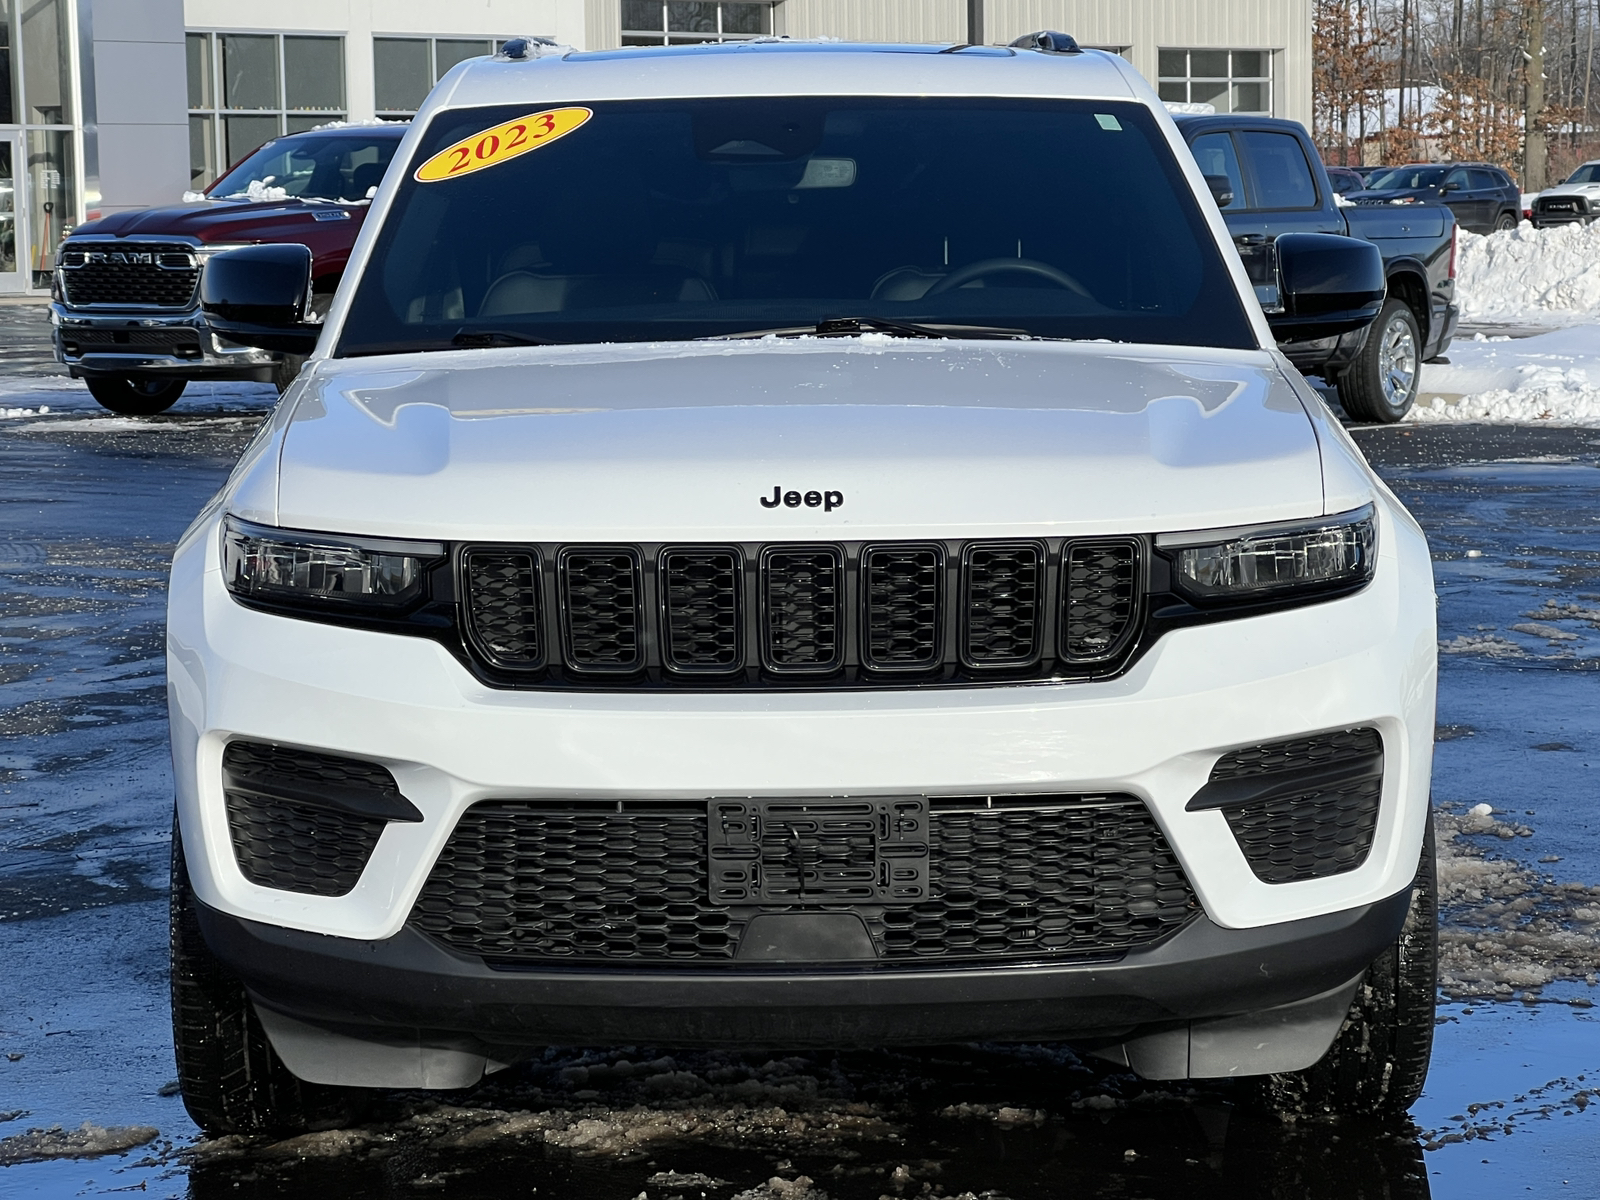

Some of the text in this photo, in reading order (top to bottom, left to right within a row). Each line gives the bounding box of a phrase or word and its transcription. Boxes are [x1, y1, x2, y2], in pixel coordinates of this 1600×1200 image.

[448, 114, 556, 174] 2023
[90, 252, 152, 265] RAM
[760, 486, 844, 512] Jeep
